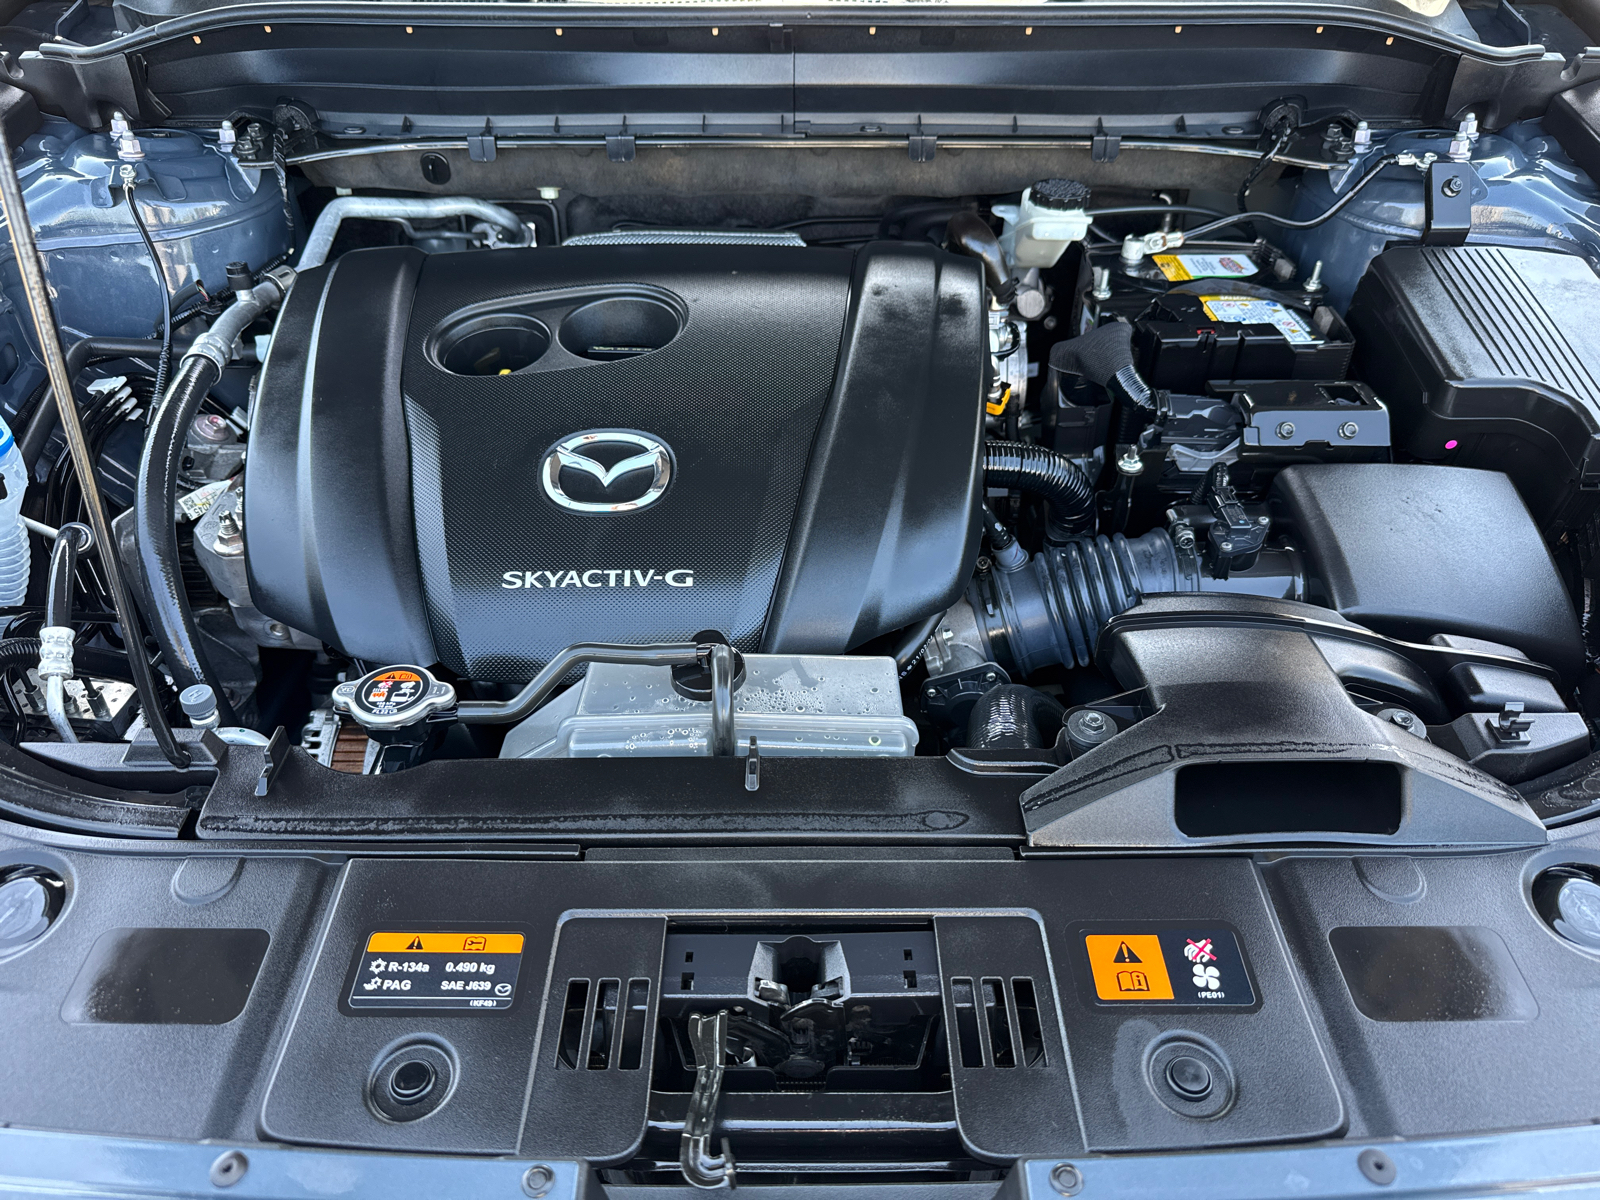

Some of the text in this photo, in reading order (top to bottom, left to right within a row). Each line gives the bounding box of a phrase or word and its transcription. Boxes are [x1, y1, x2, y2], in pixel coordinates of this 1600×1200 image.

[501, 569, 694, 589] SKYACTIV-G
[387, 962, 430, 973] R-134a
[445, 962, 496, 975] 0.490 kg
[382, 980, 412, 990] PAG
[440, 981, 492, 991] SAE J639
